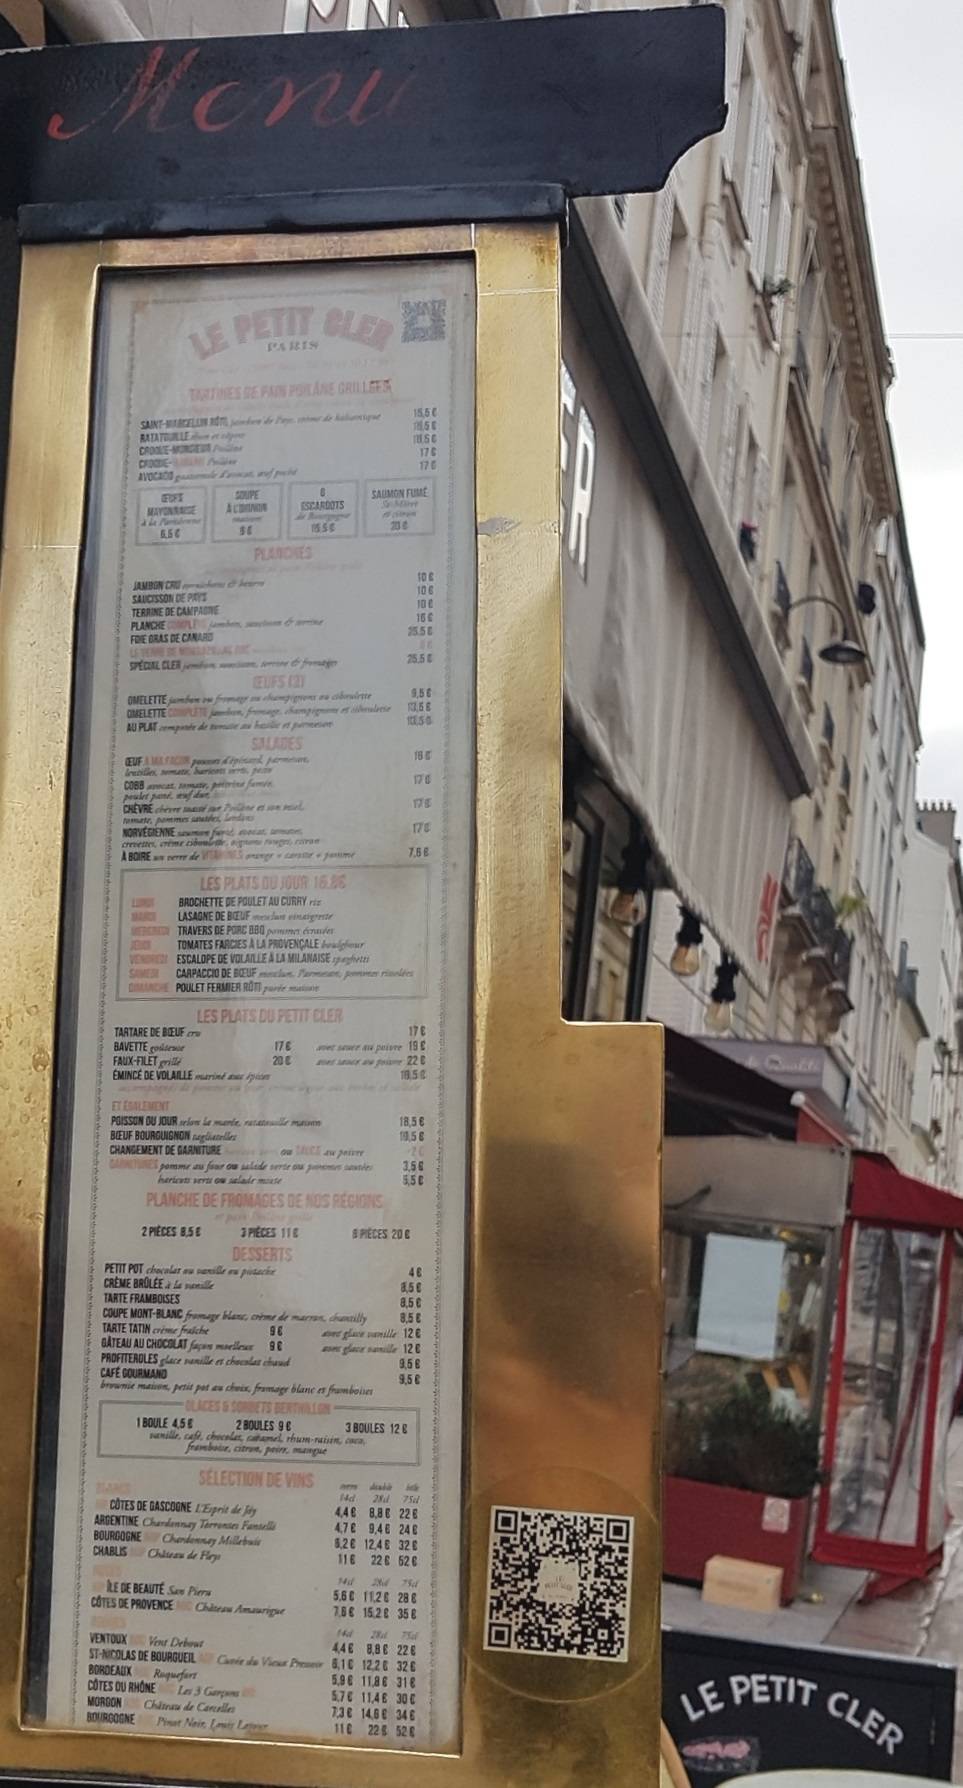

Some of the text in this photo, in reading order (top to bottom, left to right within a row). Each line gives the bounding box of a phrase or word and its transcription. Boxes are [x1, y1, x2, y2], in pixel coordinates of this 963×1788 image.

[188, 306, 394, 361] LE PETIT CLER
[267, 341, 319, 352] PARIS
[372, 488, 406, 500] SAUMON
[133, 580, 164, 591] JAMBON
[132, 593, 174, 604] SAUCISSON
[132, 607, 166, 618] TERRINE
[165, 607, 175, 617] DE
[131, 621, 165, 631] PLANCHE
[130, 632, 214, 645] FOIE GRAS DE CANARD
[162, 660, 181, 670] CLER
[127, 695, 167, 705] OMELETTE
[127, 708, 167, 719] OMELETTE
[127, 722, 158, 732] AU PLAT
[124, 780, 144, 791] COBB
[123, 802, 153, 814] CHÈVRE
[122, 826, 175, 838] NORVÉGIENNE
[128, 852, 151, 862] BOIRE
[200, 877, 221, 892] LES
[224, 875, 260, 891] PLATS
[178, 896, 307, 908] BROCHETTE DE POULET AU CURRY
[178, 911, 213, 922] LASAGNE
[215, 911, 225, 921] DE
[178, 925, 247, 936] TRAVERS DE PORC
[177, 939, 319, 951] TOMATES FARCIES PROVENÇALE
[177, 953, 330, 964] ESCALOPE DE VOLAILLE MILANAISE
[176, 968, 219, 978] CARPACCIO
[222, 968, 232, 978] DE
[176, 983, 204, 993] POULET
[207, 983, 242, 992] FERMIER
[197, 1008, 343, 1024] LES PLATS DU PETIT CLER
[114, 1027, 185, 1038] TARTARE DE BŒUF
[114, 1041, 147, 1052] BAVETTE
[113, 1056, 158, 1066] FAUX-FILET
[113, 1069, 192, 1081] ÉMINCÉ DE VOLAILLE
[111, 1116, 177, 1126] POISSON DU JOUR
[111, 1131, 190, 1141] BŒUF BOURGUIGNON
[110, 1145, 163, 1155] CHANGEMENT
[165, 1145, 176, 1155] DE
[177, 1145, 221, 1155] GARNITURE
[146, 1192, 200, 1208] PLANCHE
[202, 1192, 218, 1208] DE
[288, 1193, 301, 1208] DE
[305, 1193, 330, 1208] NOS
[332, 1191, 383, 1209] RÉGIONS
[149, 1225, 177, 1237] PIÈCES
[248, 1226, 276, 1238] PIÈCES
[359, 1227, 388, 1239] PIÈCES
[232, 1246, 293, 1261] DESSERTS
[105, 1263, 126, 1274] PETIT
[128, 1263, 143, 1274] POT
[104, 1276, 164, 1289] CRÈME BRÛLÉE
[104, 1293, 180, 1304] TARTE FRAMBOISES
[103, 1308, 183, 1319] COUPE MONT-BLANC
[102, 1323, 127, 1333] TARTE
[129, 1323, 150, 1334] TATIN
[101, 1335, 188, 1349] GÂTEAU AU CHOCOLAT
[101, 1353, 158, 1364] PROFITEROLES
[100, 1367, 167, 1379] CAFÉ GOURMAND
[142, 1418, 168, 1429] BOULE
[243, 1420, 274, 1431] BOULES
[353, 1423, 385, 1434] BOULES
[199, 1468, 314, 1488] SÉLECTION DE VINS
[110, 1498, 134, 1511] CÔTES
[137, 1501, 146, 1512] DE
[150, 1501, 192, 1513] GASCOGNE
[94, 1515, 139, 1527] ARGENTINE
[93, 1530, 141, 1542] BOURGOGNE
[93, 1546, 127, 1557] CHABLIS
[107, 1579, 165, 1595] ÎLE DE BEAUTÉ
[91, 1595, 173, 1610] CÔTES DE PROVENCE
[89, 1632, 127, 1645] VENTOUX
[89, 1648, 196, 1663] ST-NICOLAS DE BOURGUEIL
[88, 1664, 132, 1676] BORDEAUX
[88, 1679, 156, 1694] CÔTES DU RHÔNE
[87, 1696, 122, 1708] MORGON
[87, 1712, 135, 1725] BOURGOGNE
[680, 1674, 904, 1755] LE PETIT CLER
